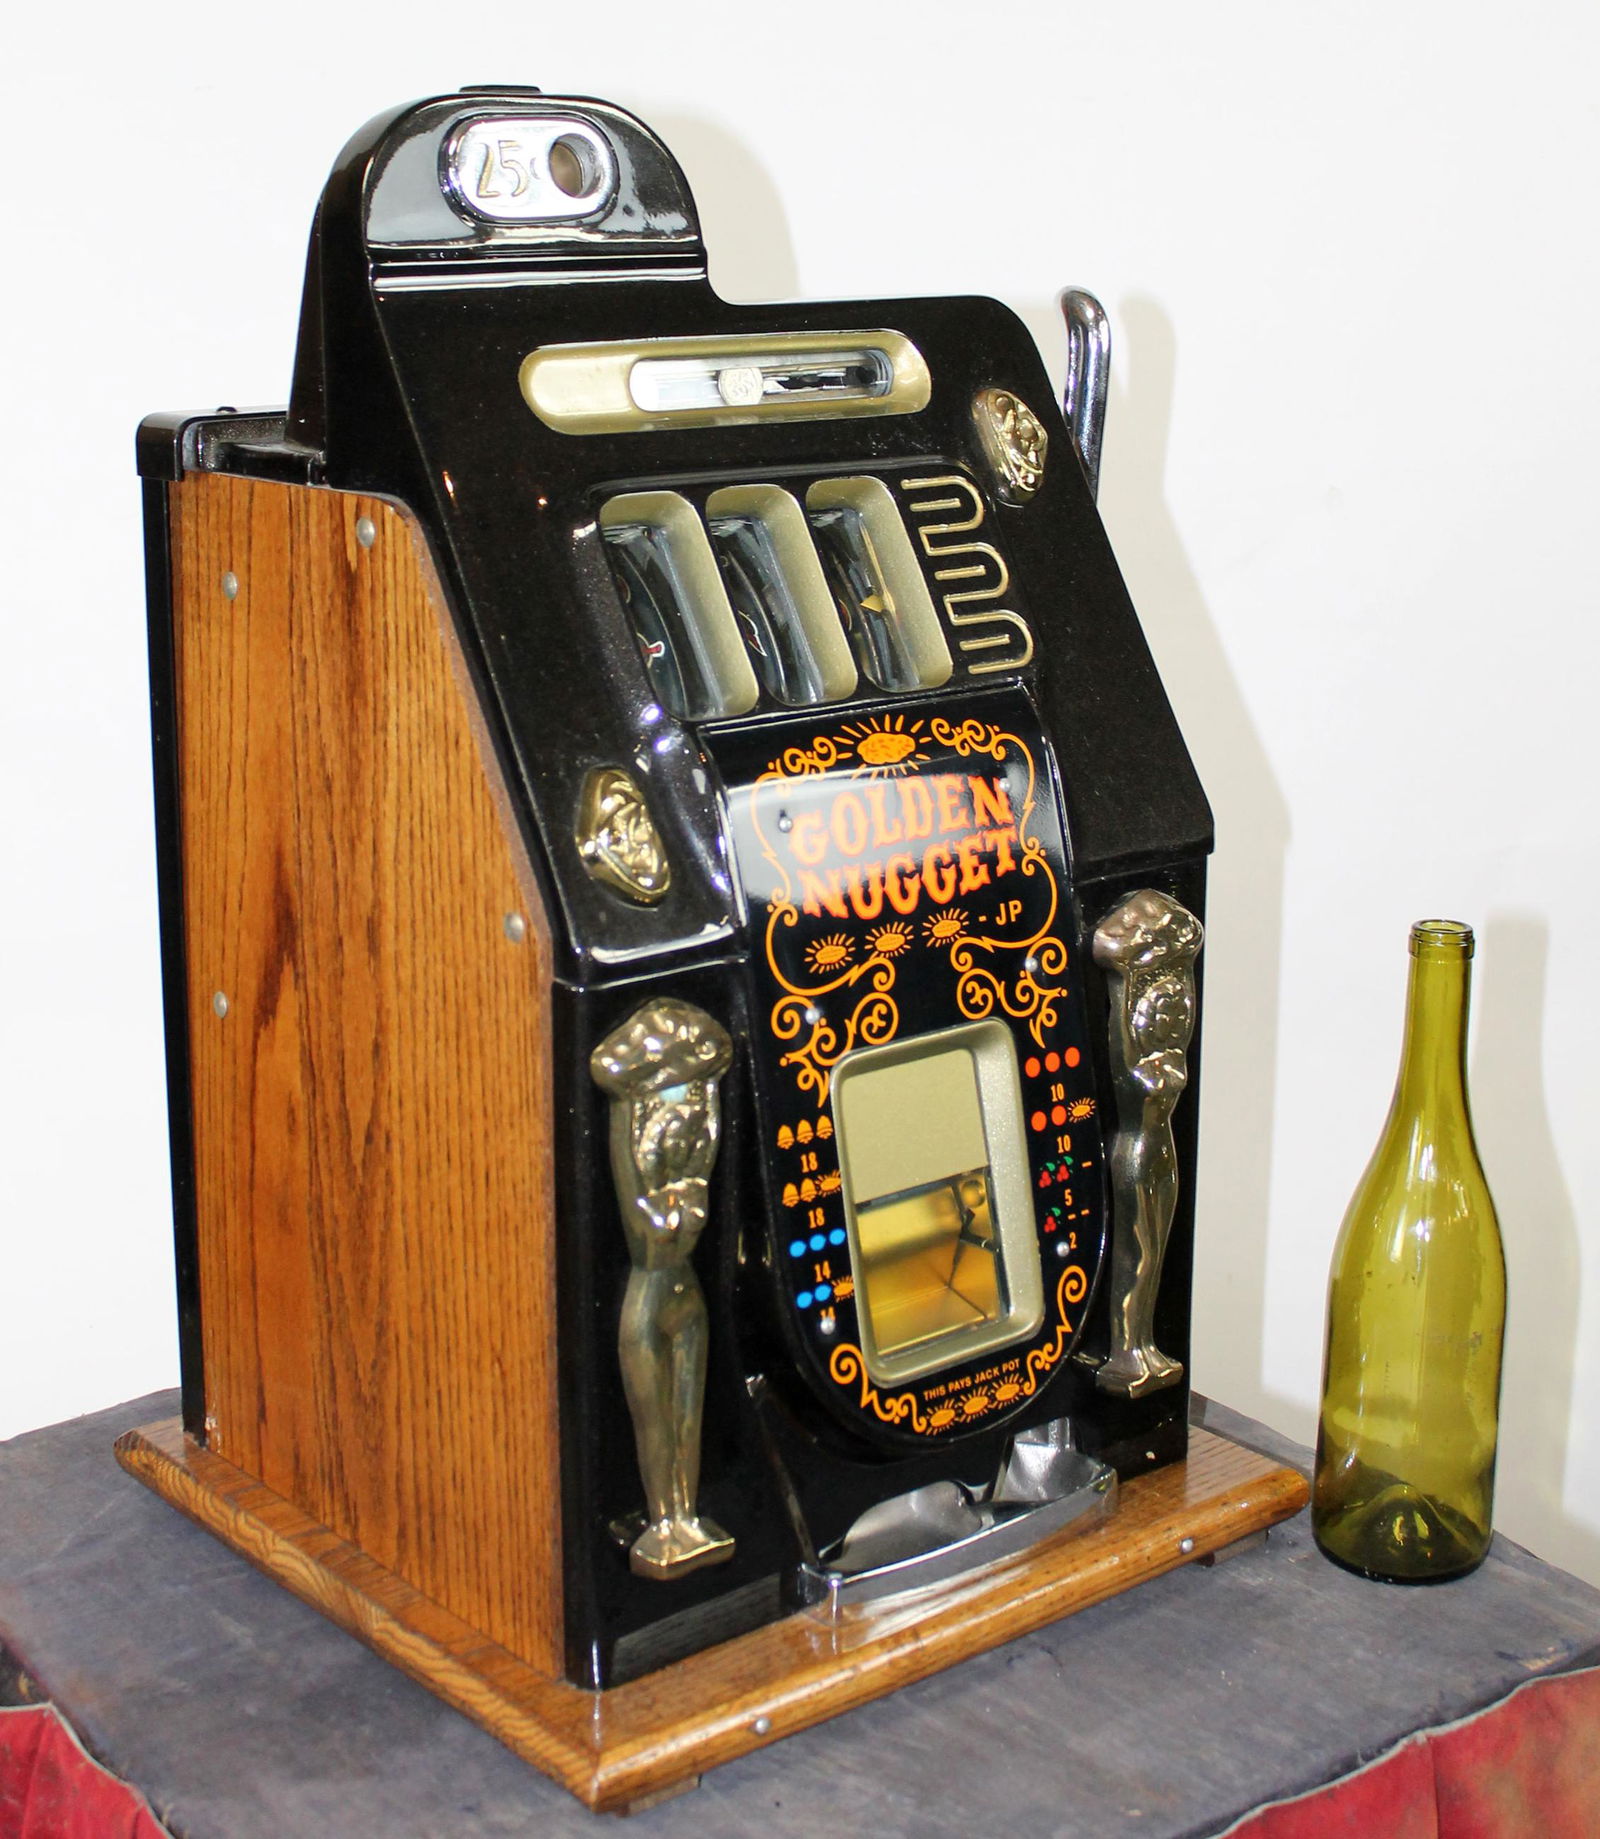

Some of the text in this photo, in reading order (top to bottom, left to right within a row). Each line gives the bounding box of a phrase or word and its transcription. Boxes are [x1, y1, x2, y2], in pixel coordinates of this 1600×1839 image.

[789, 774, 1014, 867] GOLDEN
[797, 829, 1018, 920] NUGGET
[1050, 1083, 1065, 1102] 10
[1057, 1135, 1071, 1153] 10
[801, 1152, 818, 1172] 18
[1064, 1189, 1073, 1206] 5
[809, 1208, 825, 1228] 18
[1069, 1232, 1077, 1249] 2
[815, 1261, 832, 1283] 14
[923, 1359, 1021, 1401] THIS PAYS JACK POT
